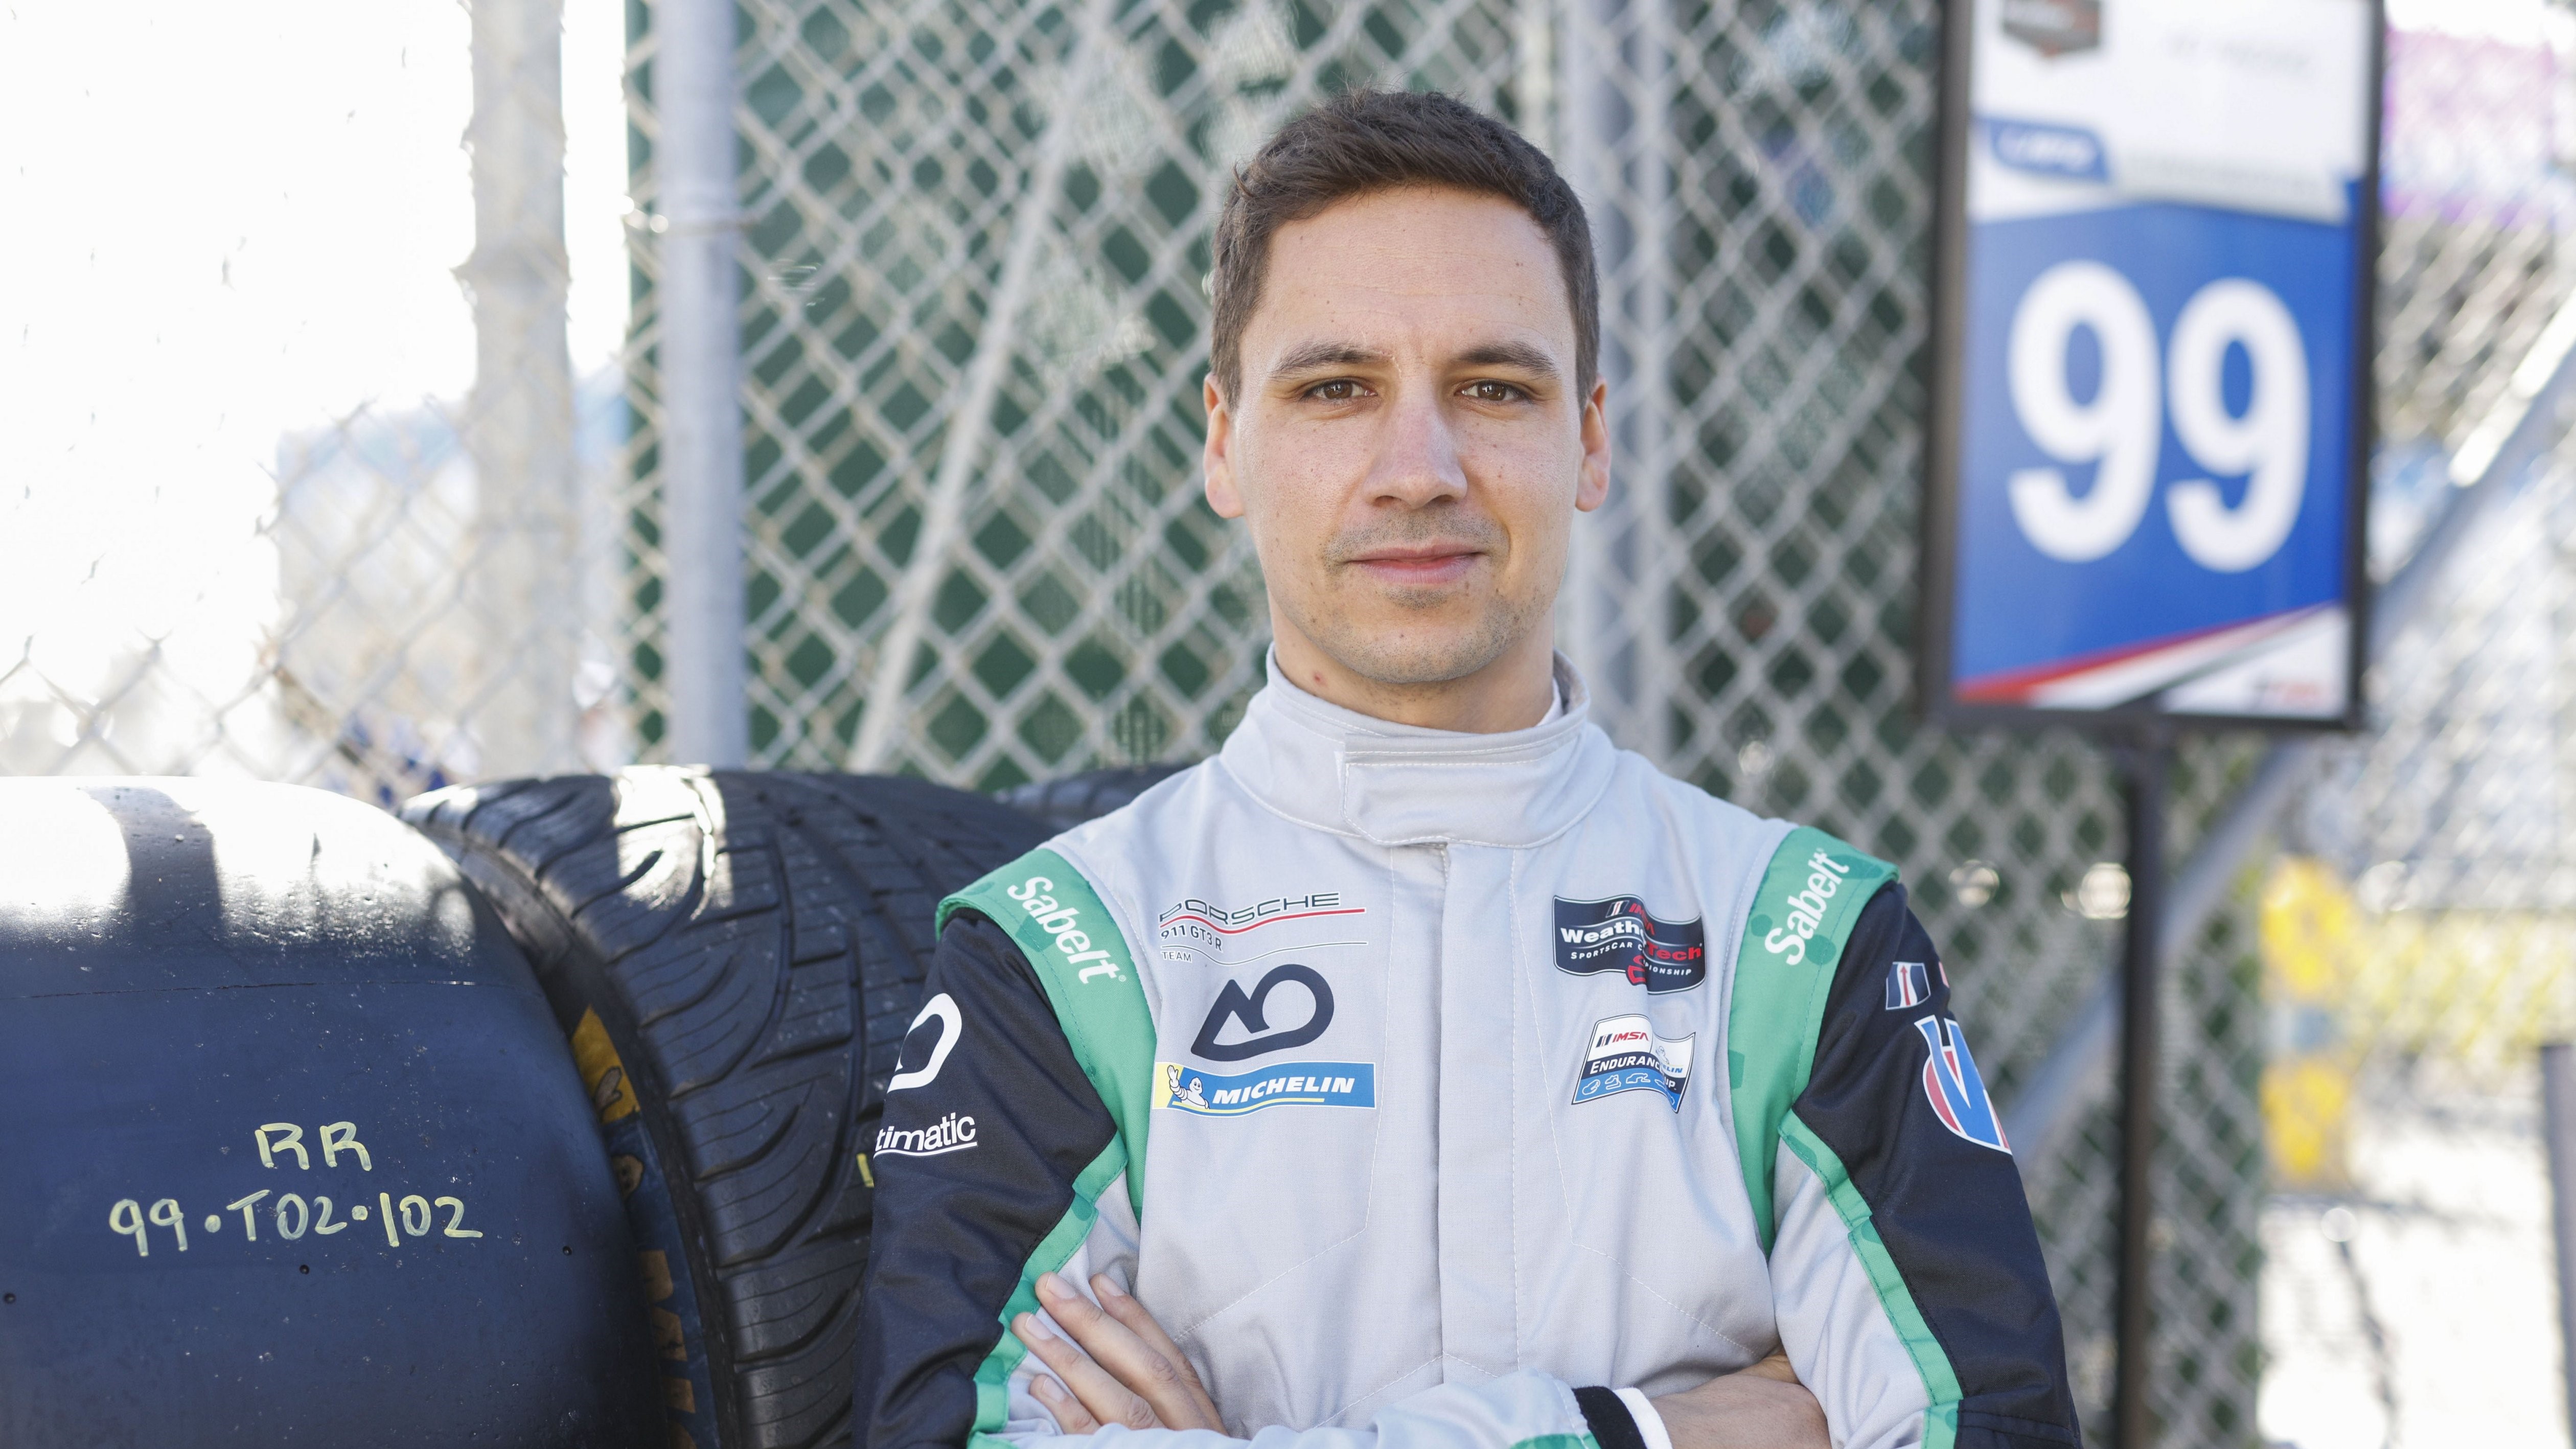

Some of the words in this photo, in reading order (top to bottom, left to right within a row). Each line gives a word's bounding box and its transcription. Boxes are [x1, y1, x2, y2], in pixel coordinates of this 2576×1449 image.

[2006, 258, 2312, 574] 99
[1159, 892, 1339, 925] PORSCHE
[1161, 925, 1186, 940] 911
[1190, 925, 1213, 946] GT3
[1215, 936, 1222, 952] R
[1161, 951, 1192, 962] TEAM
[1570, 941, 1634, 960] SPORTSCAR
[1612, 1031, 1651, 1044] IMSA
[1590, 1055, 1662, 1075] ENDURANC
[1212, 1076, 1355, 1104] MICHELIN
